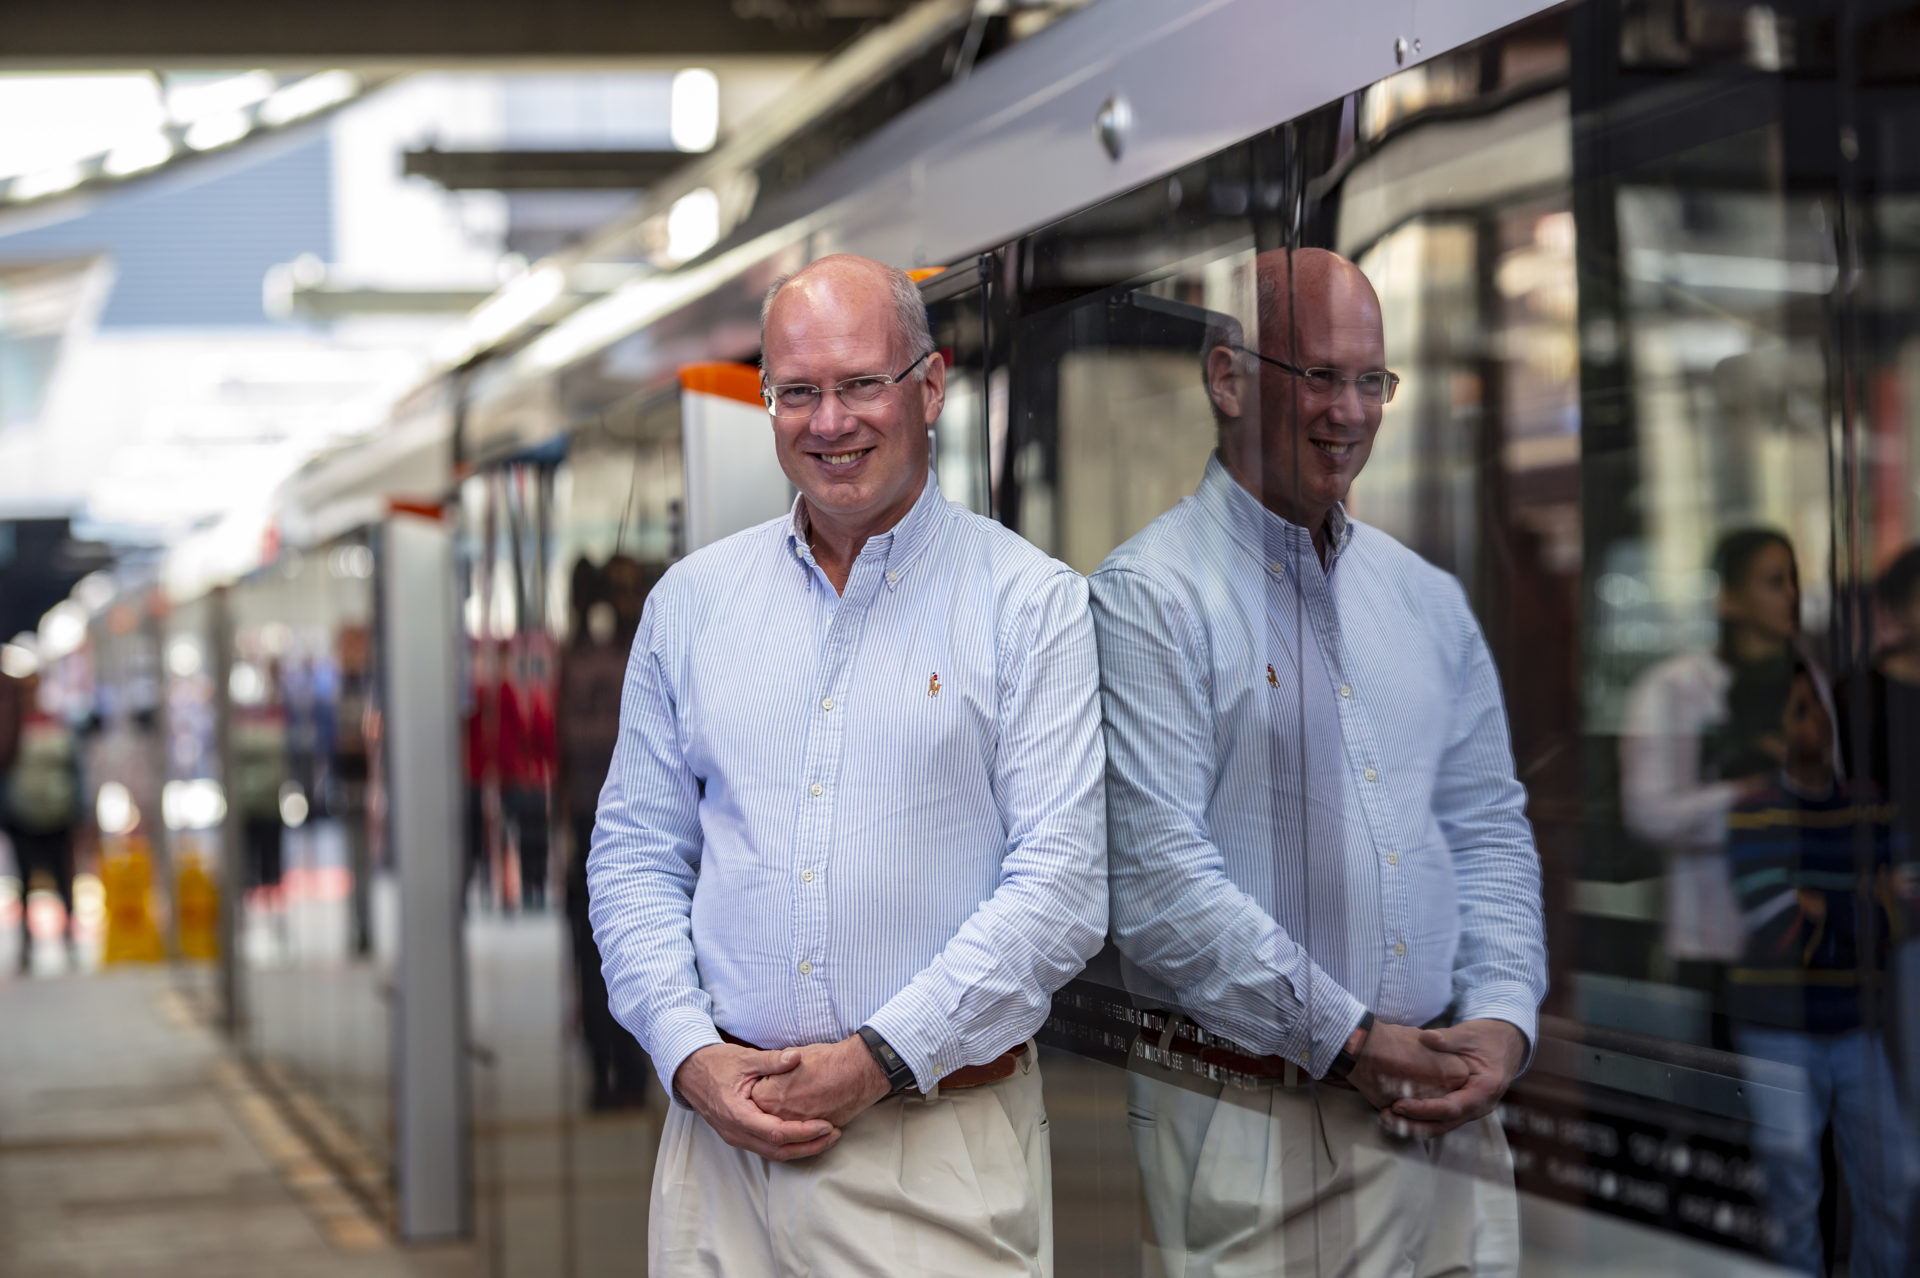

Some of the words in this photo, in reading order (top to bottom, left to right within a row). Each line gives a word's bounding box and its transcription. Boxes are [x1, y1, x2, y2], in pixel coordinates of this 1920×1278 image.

[1112, 1003, 1135, 1024] FEELING
[1136, 1010, 1141, 1026] IS
[1143, 1012, 1166, 1033] MUTUAL
[1136, 1041, 1143, 1058] SO
[1144, 1044, 1161, 1062] MUCH
[1162, 1049, 1170, 1067] TO
[1171, 1053, 1183, 1070] SEE
